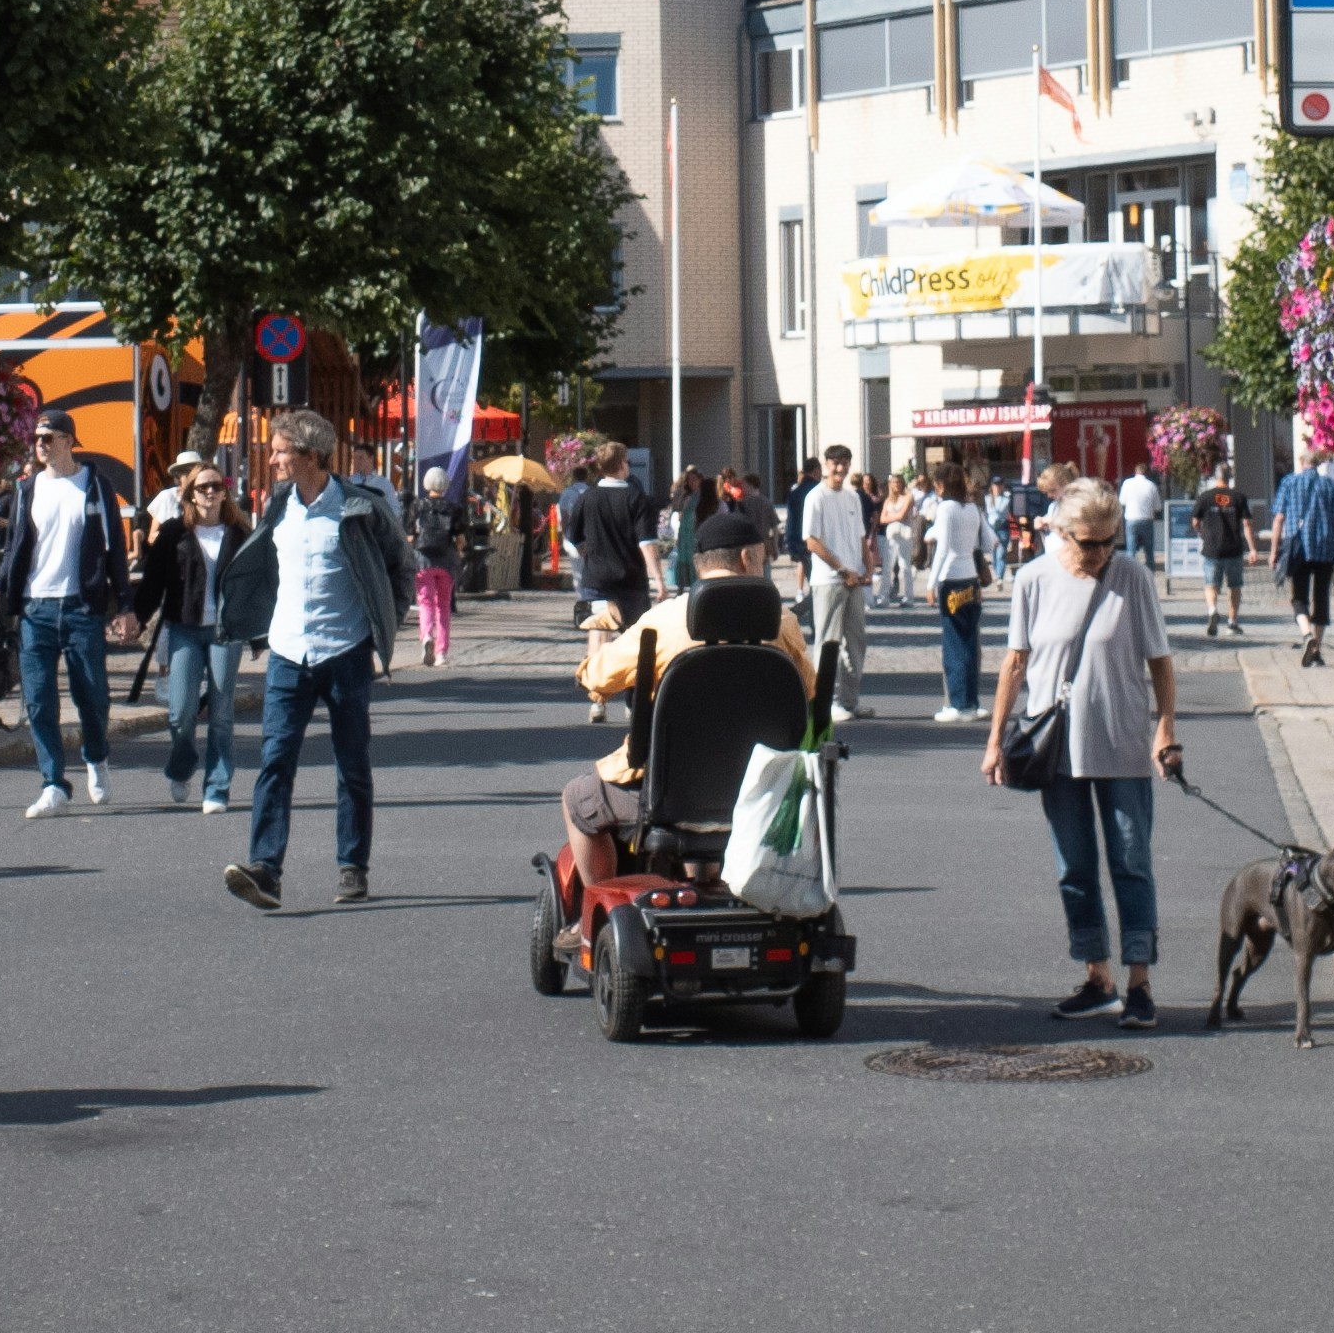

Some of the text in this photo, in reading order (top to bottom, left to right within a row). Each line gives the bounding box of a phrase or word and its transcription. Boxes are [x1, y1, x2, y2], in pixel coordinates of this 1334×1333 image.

[924, 408, 976, 425] KREMEN
[978, 407, 997, 423] AV
[722, 932, 763, 942] crosser
